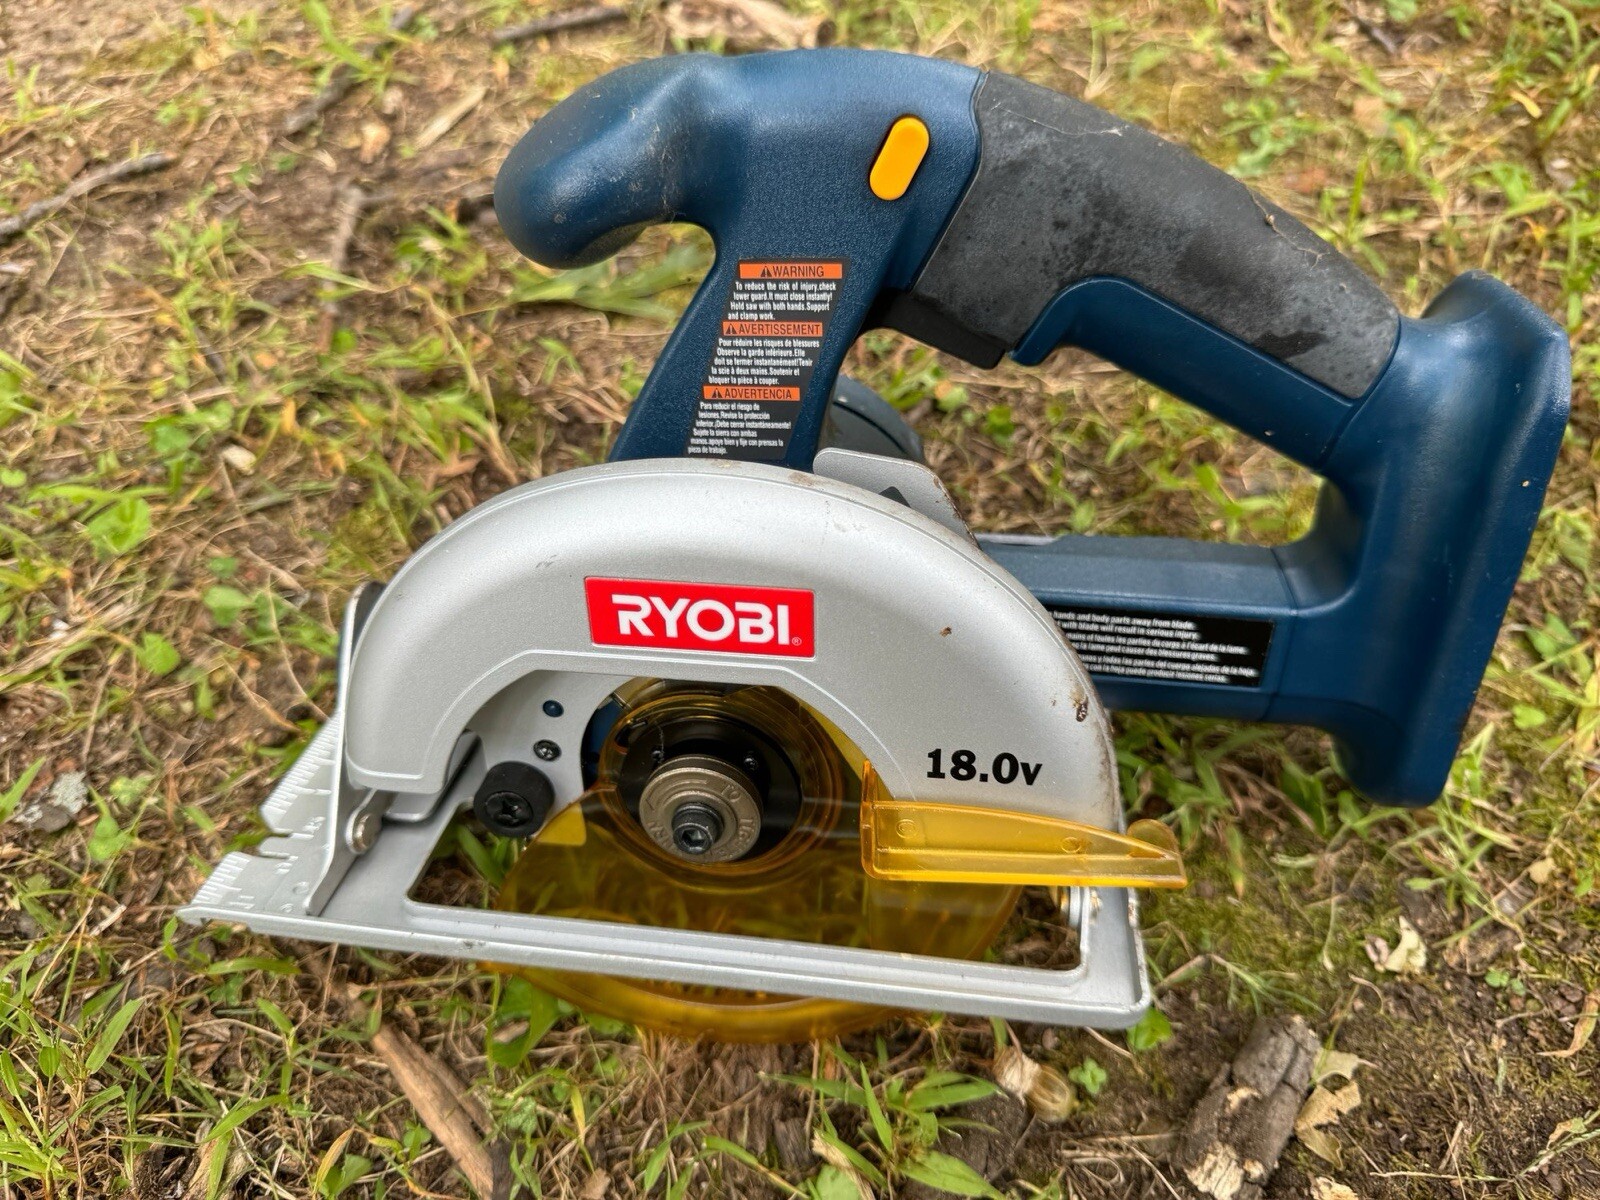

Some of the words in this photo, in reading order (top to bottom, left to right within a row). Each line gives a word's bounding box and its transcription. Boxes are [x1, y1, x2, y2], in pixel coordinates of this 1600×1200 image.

[773, 266, 824, 277] WARNING
[736, 282, 742, 290] To
[744, 282, 764, 290] reduce
[766, 282, 776, 290] the
[778, 282, 790, 290] risk
[792, 282, 798, 290] of
[734, 292, 750, 300] lower
[790, 292, 804, 300] close
[806, 292, 832, 302] instantly!
[730, 302, 744, 310] Hold
[759, 302, 772, 310] with
[772, 302, 786, 310] both
[728, 312, 738, 320] and
[740, 312, 758, 321] clamp
[759, 312, 776, 320] work.
[739, 324, 820, 335] AVERTISSEMENT
[718, 338, 732, 346] Pour
[732, 338, 752, 346] réduire
[754, 338, 762, 347] les
[763, 339, 784, 348] risques
[784, 339, 792, 348] de
[792, 339, 820, 348] blessures
[717, 348, 740, 356] Observe
[741, 348, 746, 356] la
[748, 348, 764, 358] garde
[714, 357, 725, 366] doit
[734, 358, 752, 366] fermer
[711, 366, 718, 375] la
[718, 367, 730, 375] scie
[736, 367, 750, 375] deux
[794, 368, 800, 376] et
[724, 388, 792, 398] ADVERTENCIA
[611, 594, 790, 646] RYOBI
[1053, 610, 1076, 620] hands
[1076, 612, 1090, 621] and
[1092, 614, 1110, 624] body
[1110, 616, 1130, 624] parts
[1131, 618, 1152, 627] away
[1152, 618, 1170, 628] from
[1062, 620, 1078, 629] with
[1078, 622, 1099, 631] blade
[1100, 624, 1114, 632] will
[1114, 626, 1136, 634] result
[1137, 627, 1145, 635] in
[1146, 628, 1174, 638] serious
[927, 748, 1043, 786] 18.0v
